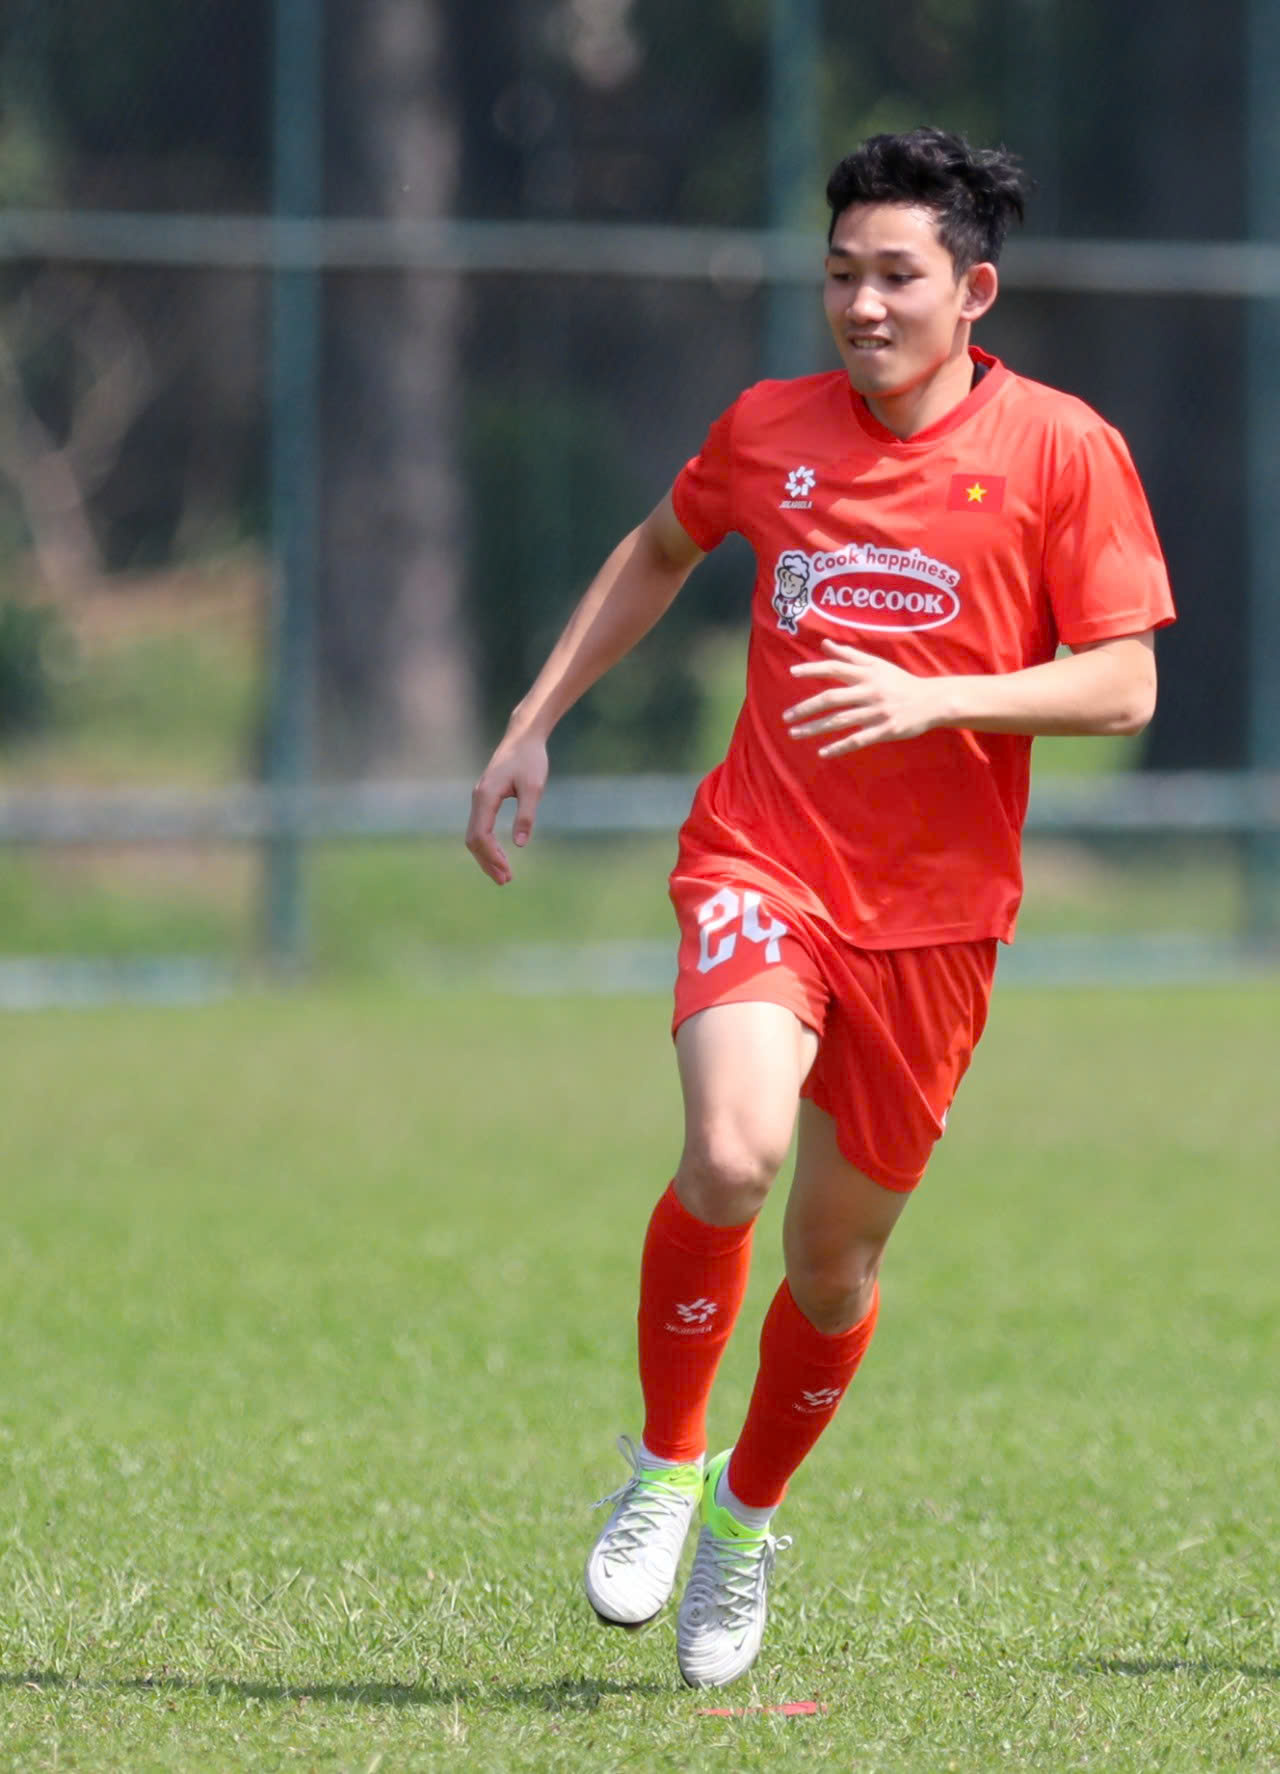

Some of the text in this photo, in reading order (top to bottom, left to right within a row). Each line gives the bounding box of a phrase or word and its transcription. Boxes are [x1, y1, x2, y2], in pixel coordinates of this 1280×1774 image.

[813, 548, 956, 586] Cook happiness
[697, 887, 787, 974] 24
